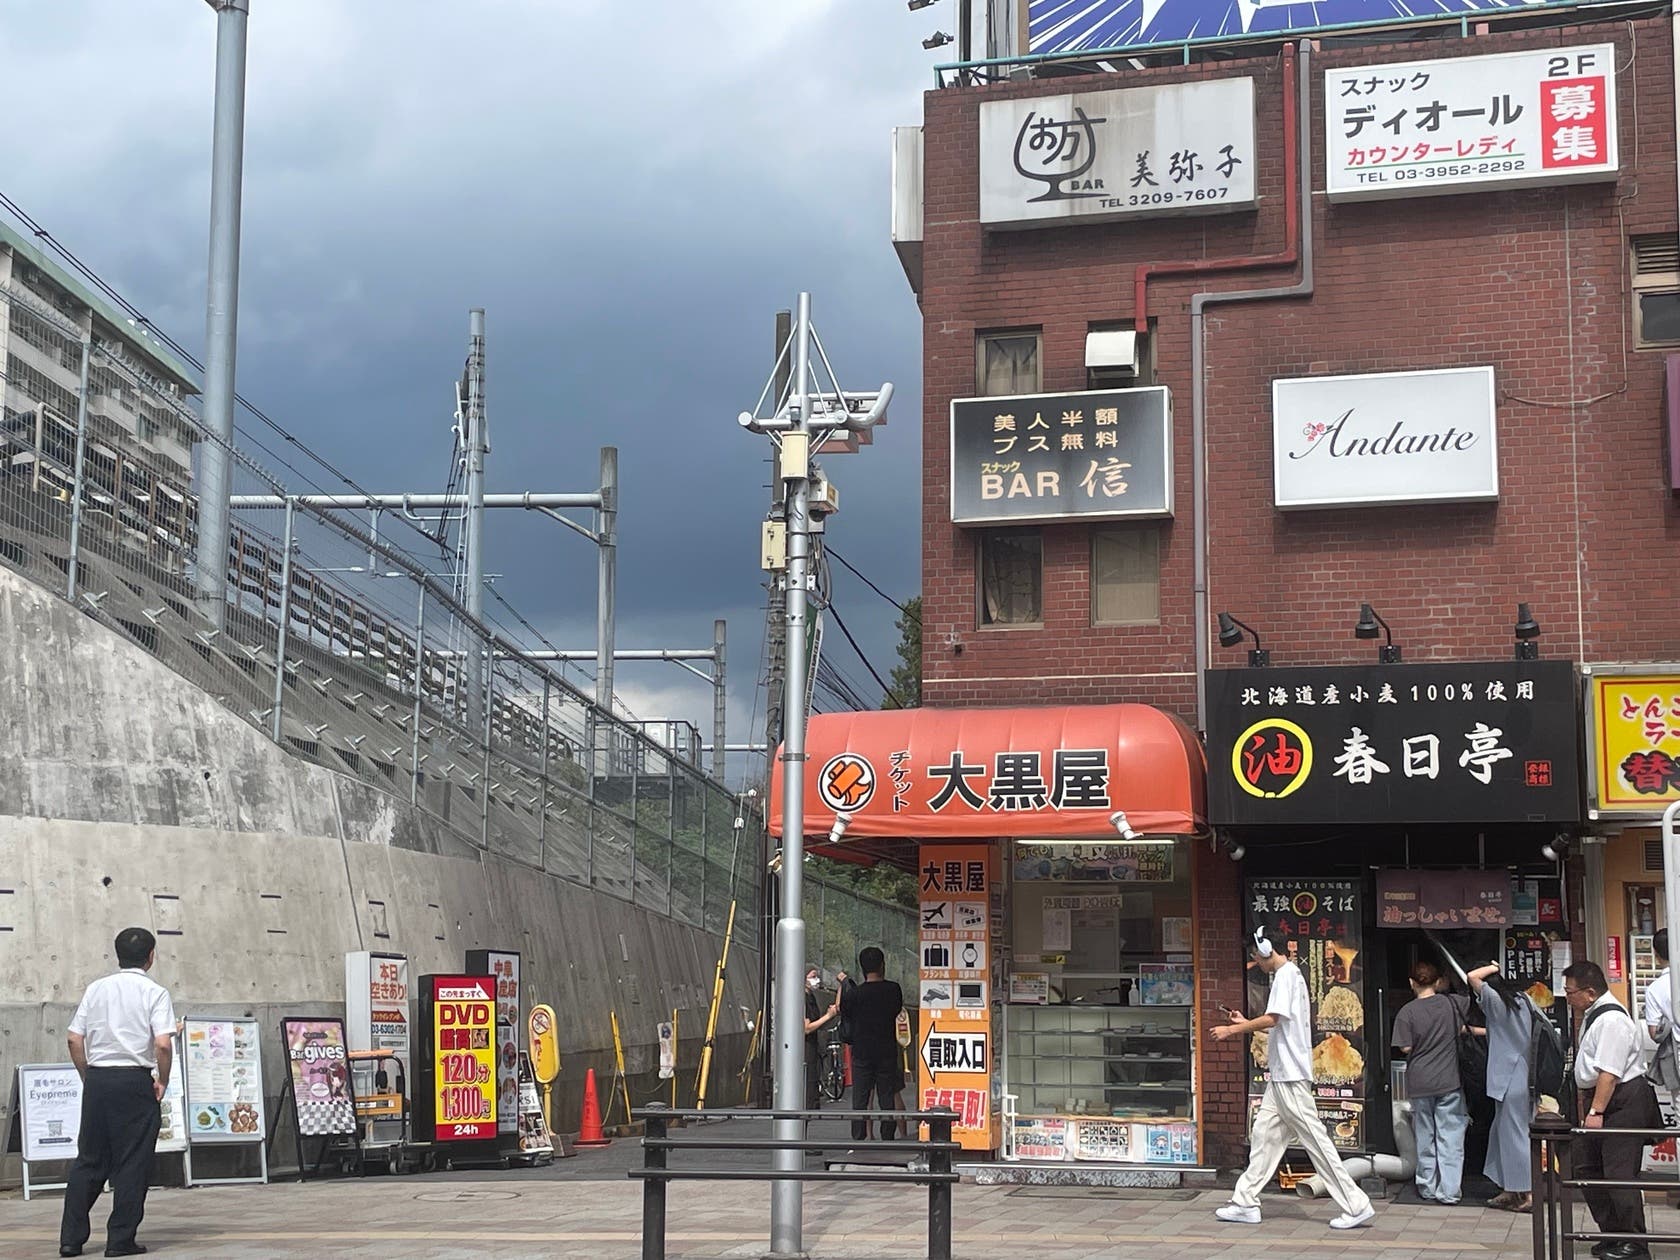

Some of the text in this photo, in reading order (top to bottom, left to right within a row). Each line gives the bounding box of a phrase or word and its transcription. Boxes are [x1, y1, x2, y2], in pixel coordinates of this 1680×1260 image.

[1548, 54, 1595, 77] 2F
[1340, 72, 1430, 96] スナック
[1343, 95, 1523, 138] ディオール
[1550, 84, 1597, 161] 募集
[1348, 136, 1516, 165] カウンターレディ
[1130, 144, 1242, 188] 美弥子
[1357, 160, 1525, 183] TEL 03-3952-2292
[1071, 179, 1104, 191] BAR
[1100, 187, 1228, 208] TEL 3209-7607
[994, 407, 1118, 432] 美人半額
[1288, 408, 1481, 460] Andante
[994, 430, 1118, 454] ブス無料
[981, 461, 1021, 473] スナック
[981, 457, 1132, 500] BAR 信
[1244, 733, 1302, 785] 油
[1332, 722, 1514, 785] 春日亭
[889, 750, 913, 812] チケット
[927, 749, 1111, 811] 大黒屋
[1622, 750, 1680, 793] 替
[922, 860, 985, 893] 大黒屋
[380, 963, 397, 980] 本日
[440, 1004, 489, 1025] DVD
[304, 1041, 345, 1065] gives
[929, 1038, 985, 1069] 買取入口
[454, 1124, 478, 1135] 24h
